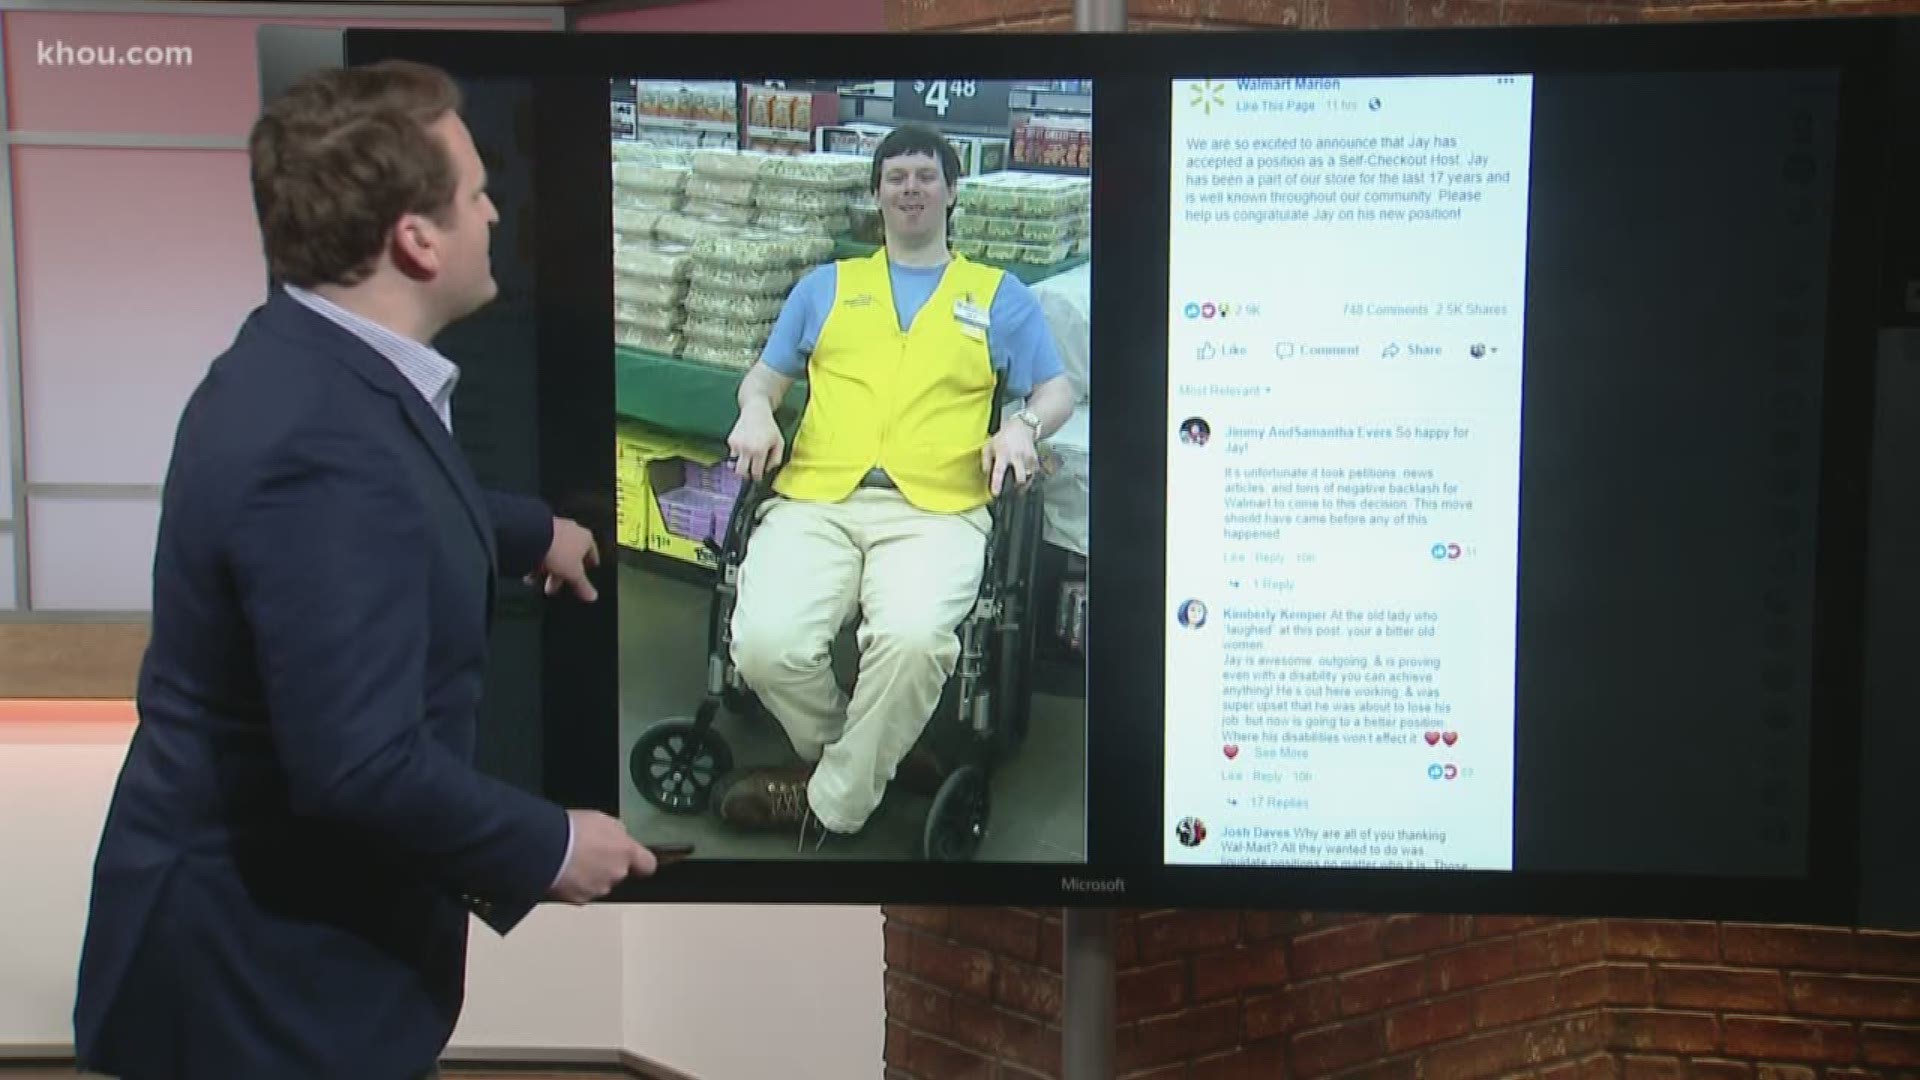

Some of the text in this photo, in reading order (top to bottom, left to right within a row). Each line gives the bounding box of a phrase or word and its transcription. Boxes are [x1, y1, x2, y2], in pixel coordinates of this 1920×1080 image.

[1236, 78, 1341, 90] Walmart Marion
[1187, 136, 1457, 151] We are so excited to announce that Jay has
[1186, 155, 1489, 171] accepted a position as a Self-Checkout Jay
[1186, 172, 1510, 188] has been a part of our store for the last 17 years and
[1186, 190, 1482, 205] is well known throughout our Please
[1186, 208, 1462, 224] help us congratulate Jay on his new position!
[1300, 344, 1360, 356] Comment
[1407, 343, 1442, 355] Share
[1224, 426, 1470, 441] Jimmy AndSamantha So happy for
[1225, 441, 1249, 455] Jay!
[1244, 468, 1433, 478] unfortunate took news
[1271, 483, 1458, 496] and tons of negative backlash for
[1224, 498, 1473, 510] Walmart to come to this This move
[1224, 514, 1428, 527] should have came before any of this
[1223, 610, 1438, 624] Kimberly Kemper At the old lady who
[1279, 625, 1435, 638] at this your a bitter old
[1223, 655, 1441, 669] Jay is & is proving
[1222, 671, 1433, 685] even with a disability you can achieve
[1304, 687, 1322, 696] out
[1325, 686, 1350, 697] here
[1405, 686, 1414, 697] &
[1417, 688, 1440, 697] was
[1222, 701, 1451, 714] super upset that he was about to lose his
[1245, 716, 1397, 730] but now is going to a better
[1222, 732, 1340, 743] Where his disabilities
[1221, 827, 1447, 843] Josh Why are all of you thanking
[1221, 843, 1424, 857] Wal-Mart? All they wanted to do was
[1061, 877, 1126, 892] Microsoft
